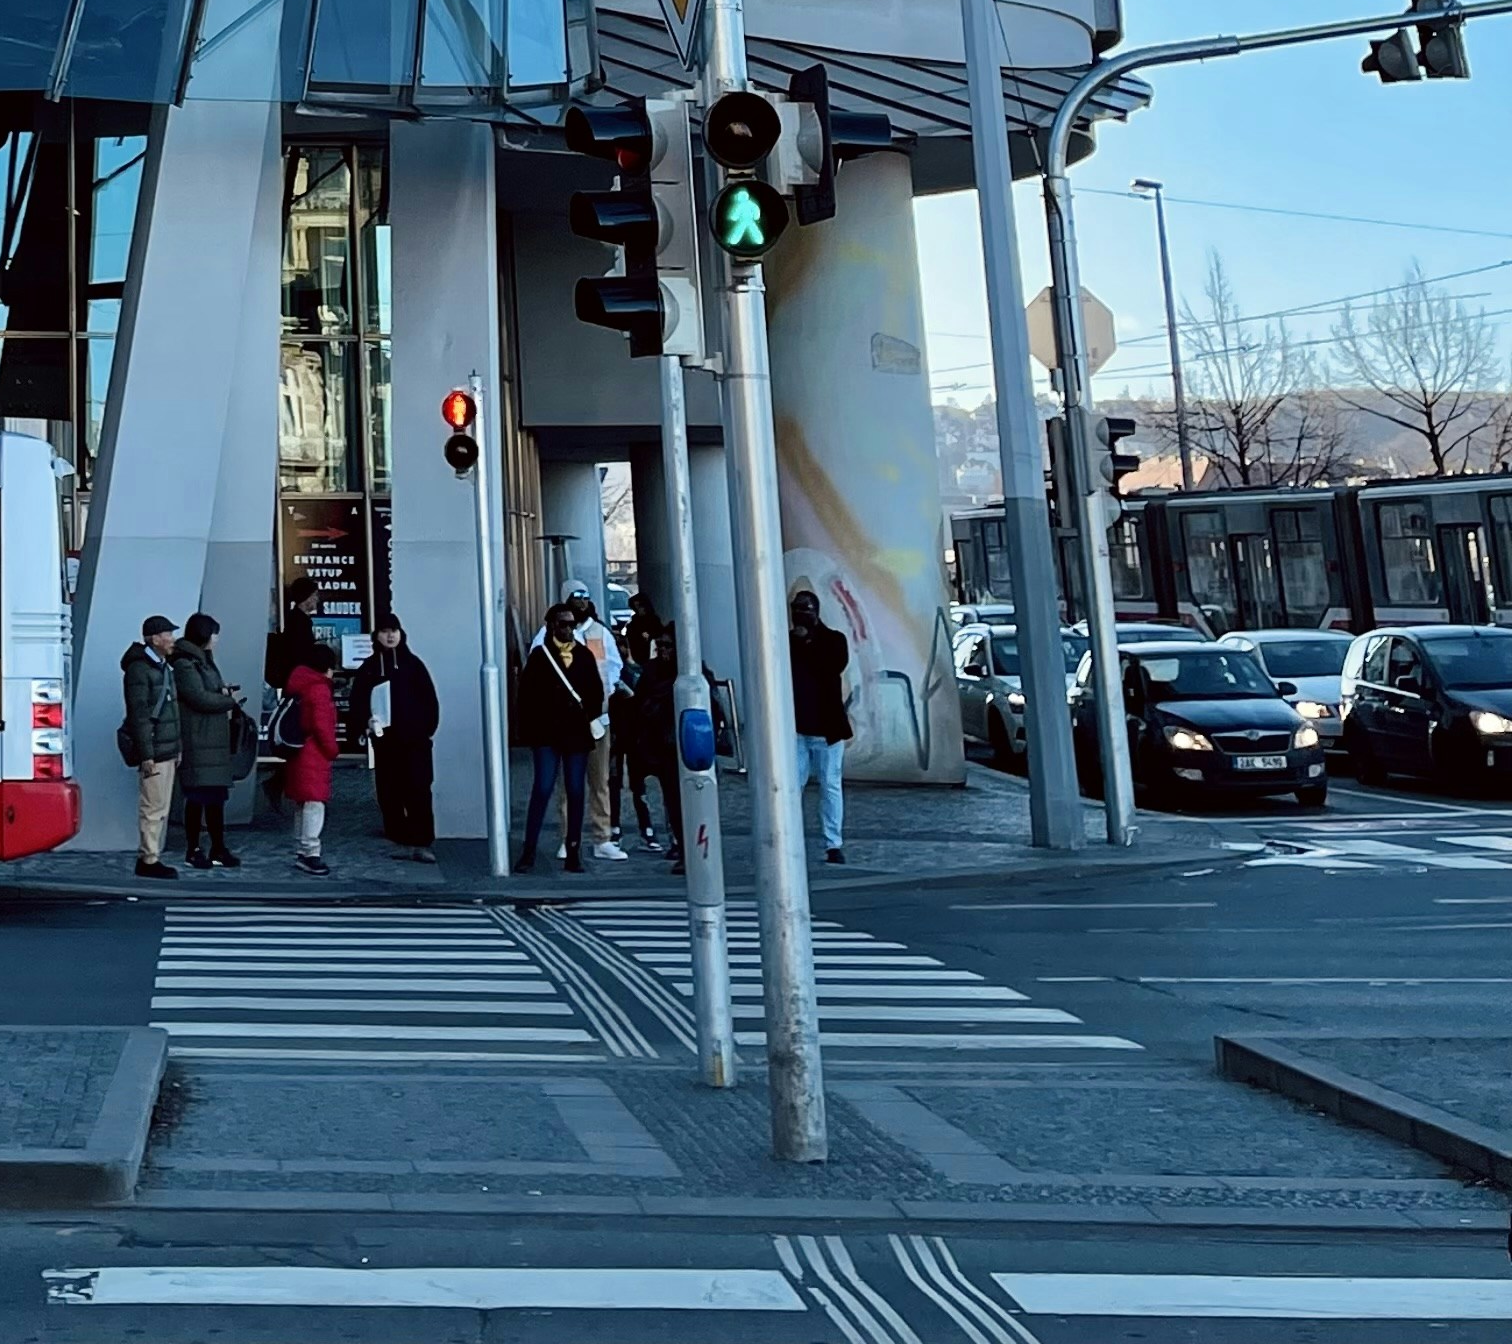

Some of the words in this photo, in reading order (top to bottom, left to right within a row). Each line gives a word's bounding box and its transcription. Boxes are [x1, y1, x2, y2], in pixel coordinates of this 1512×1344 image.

[293, 555, 355, 565] ENTRANCE
[306, 568, 343, 577] VSTUP
[322, 601, 362, 615] SAUDEK
